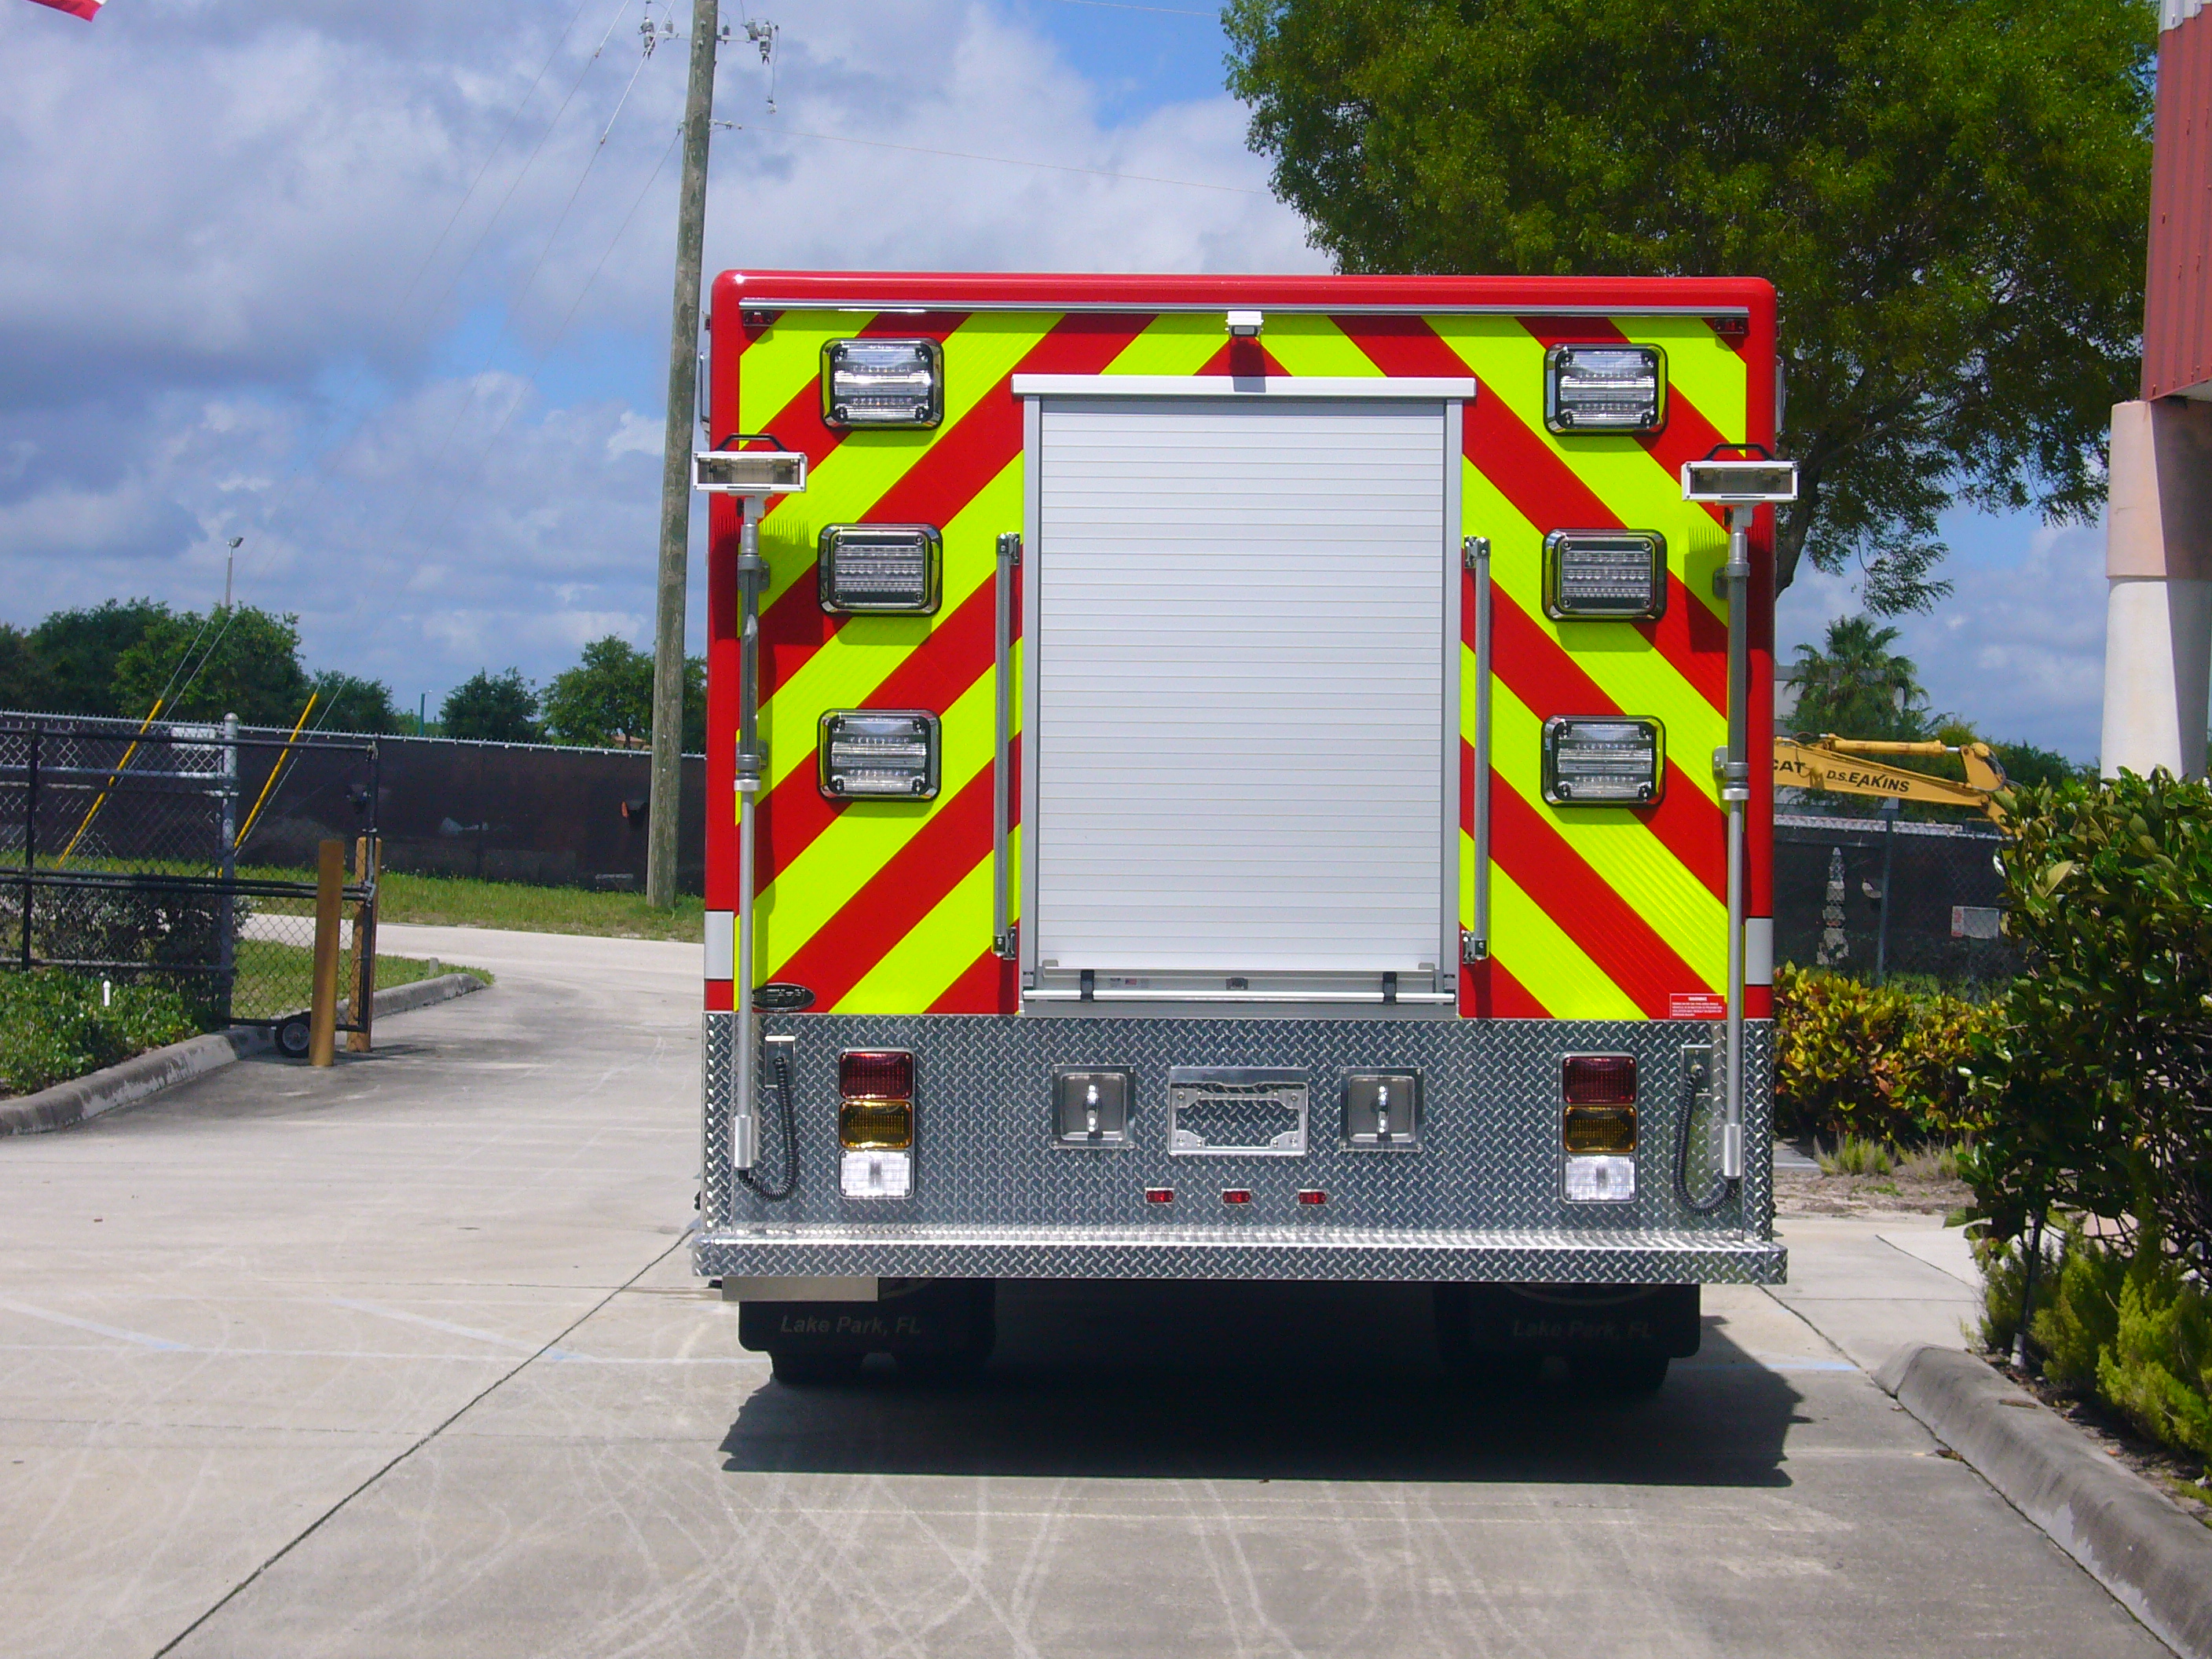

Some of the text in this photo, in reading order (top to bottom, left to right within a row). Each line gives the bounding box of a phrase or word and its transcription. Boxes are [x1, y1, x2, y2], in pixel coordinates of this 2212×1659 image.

[780, 1315, 922, 1336] Lake Park, FL
